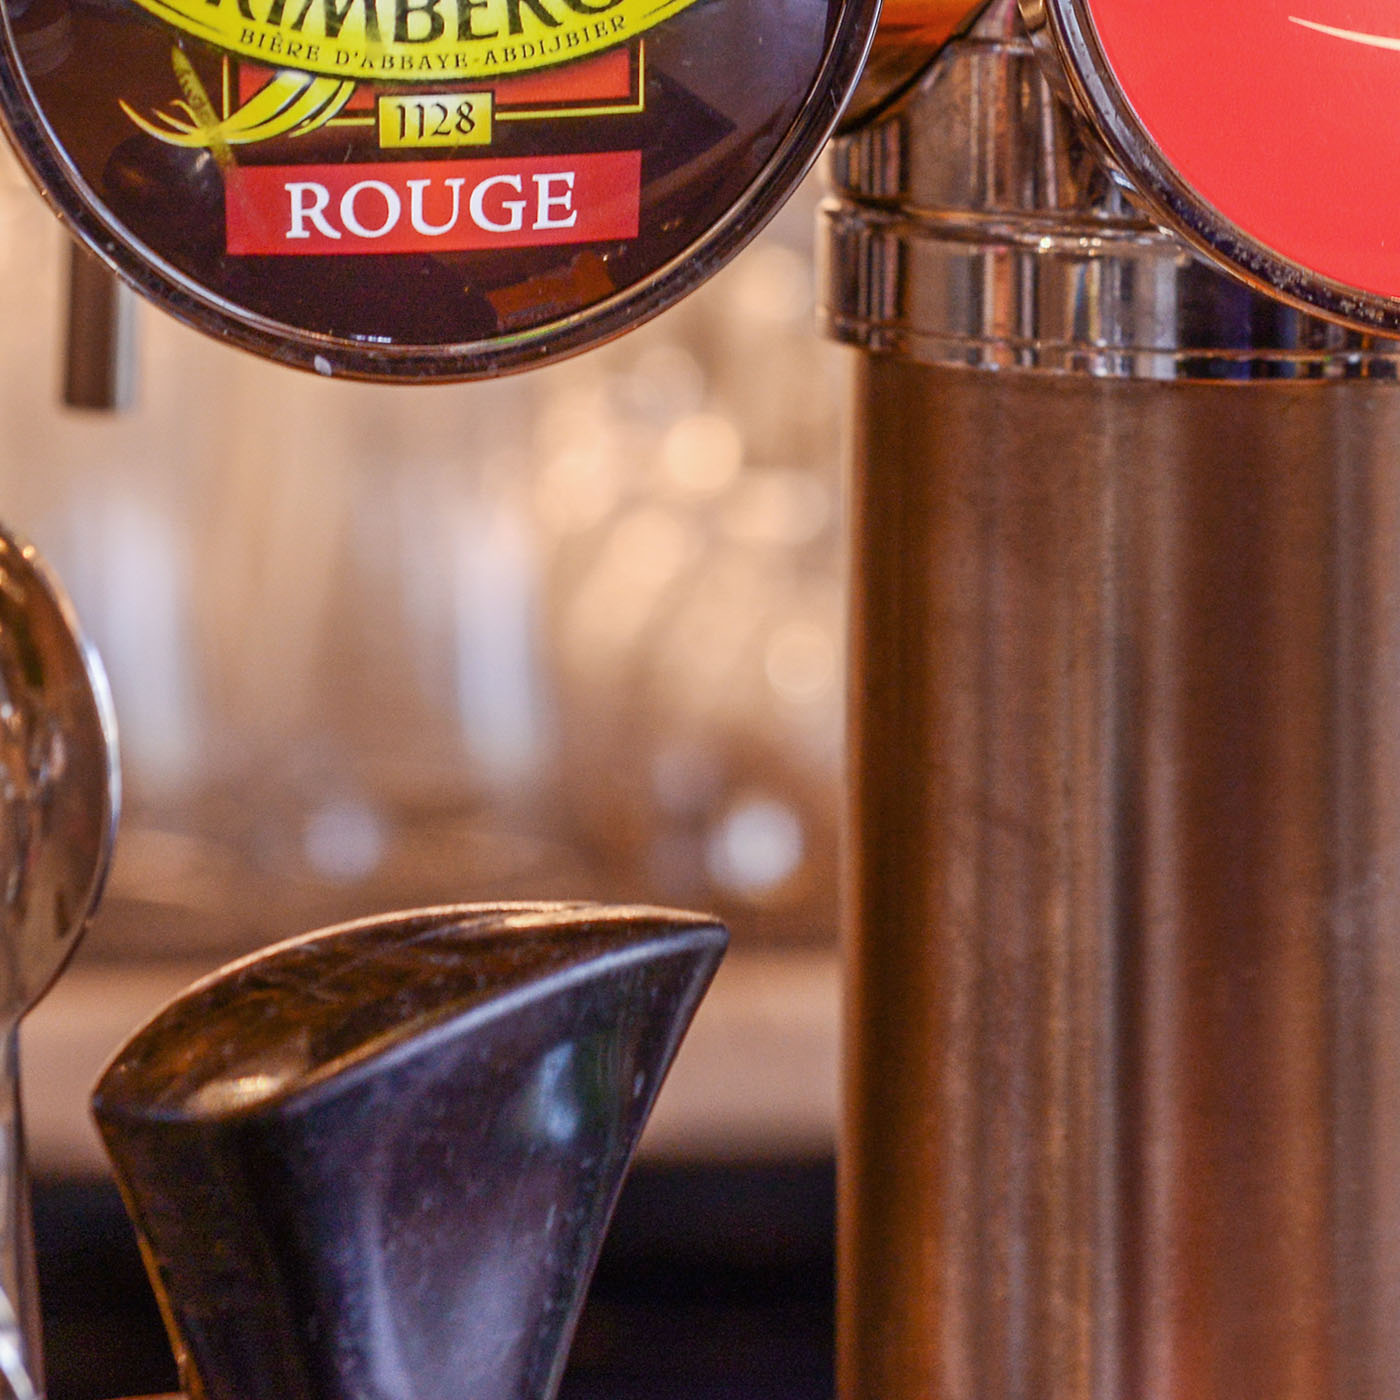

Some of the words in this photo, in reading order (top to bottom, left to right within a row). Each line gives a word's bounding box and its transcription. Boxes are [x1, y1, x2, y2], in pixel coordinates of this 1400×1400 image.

[239, 28, 320, 63] BIÈRE
[394, 101, 477, 141] 1128
[283, 171, 579, 241] ROUGE
